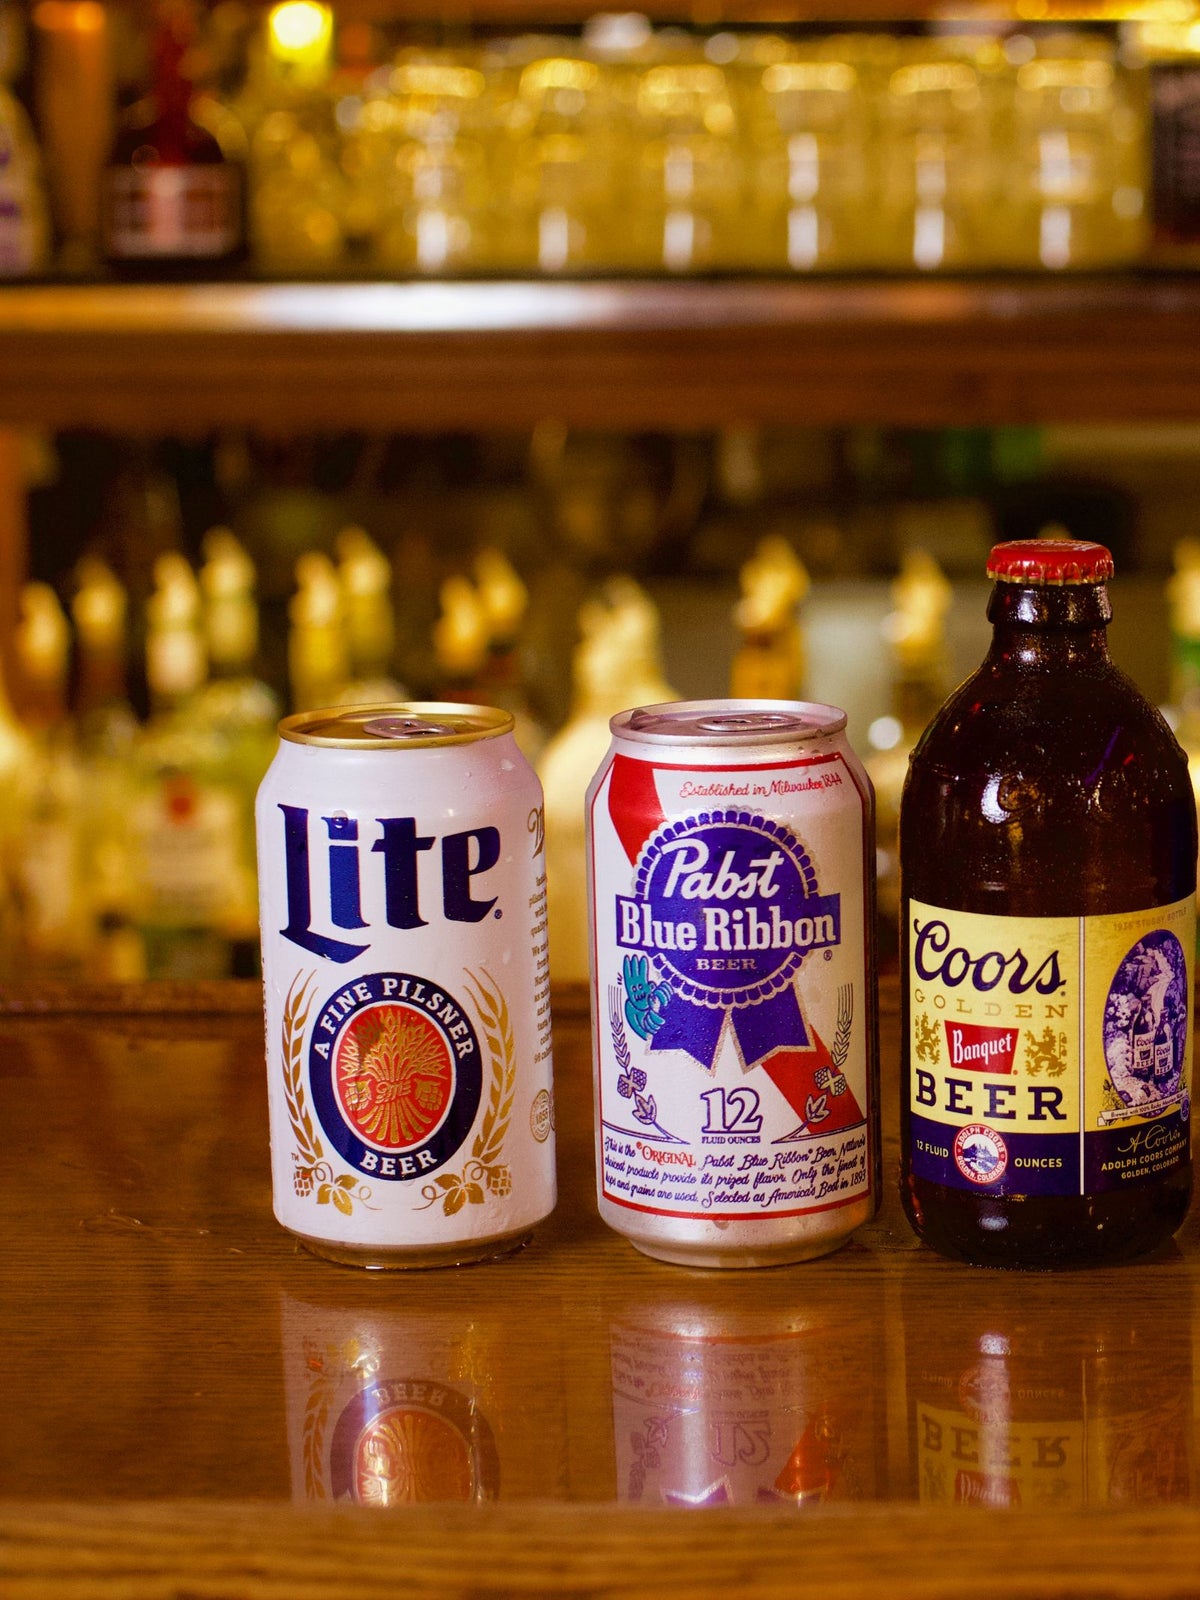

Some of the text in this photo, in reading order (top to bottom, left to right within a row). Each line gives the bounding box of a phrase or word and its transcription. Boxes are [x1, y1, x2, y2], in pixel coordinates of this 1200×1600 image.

[679, 772, 842, 798] Established in Milwaukee 1844
[277, 803, 501, 964] Lite
[659, 837, 785, 900] Pabst
[619, 900, 837, 951] Blue Ribbon
[696, 958, 757, 971] BEER
[914, 918, 1067, 997] Coors
[320, 982, 373, 1036] FINE
[382, 978, 475, 1059] PILSNER
[914, 988, 1068, 1019] GOLDEN
[314, 1041, 331, 1060] A
[952, 1029, 1012, 1065] Banquet
[700, 1087, 763, 1134] 12
[915, 1068, 1067, 1121] BEER
[604, 1136, 617, 1152] This
[624, 1144, 636, 1158] the
[698, 1154, 735, 1170] Pabst
[737, 1153, 769, 1171] Blue
[701, 1135, 761, 1145] FLUID OUNCES
[915, 1139, 1063, 1168] 12 FLUID OUNCES
[957, 1126, 1006, 1152] ADOLPH COORS
[1101, 1137, 1187, 1171] ADOLPH COORS COMPANY
[359, 1149, 438, 1176] BEER
[626, 1163, 660, 1180] products
[660, 1171, 697, 1185] provide
[700, 1172, 714, 1185] its
[714, 1173, 750, 1190] prized
[791, 1166, 818, 1184] Only
[821, 1163, 836, 1177] the
[836, 1154, 858, 1178] finest
[1121, 1155, 1179, 1180] GOLDEN, COLORADO
[617, 1178, 630, 1190] and
[630, 1183, 656, 1198] grains
[656, 1189, 673, 1200] are
[701, 1190, 751, 1209] Selected
[752, 1192, 766, 1203] as
[760, 1183, 816, 1208] America's
[815, 1179, 840, 1200] Best
